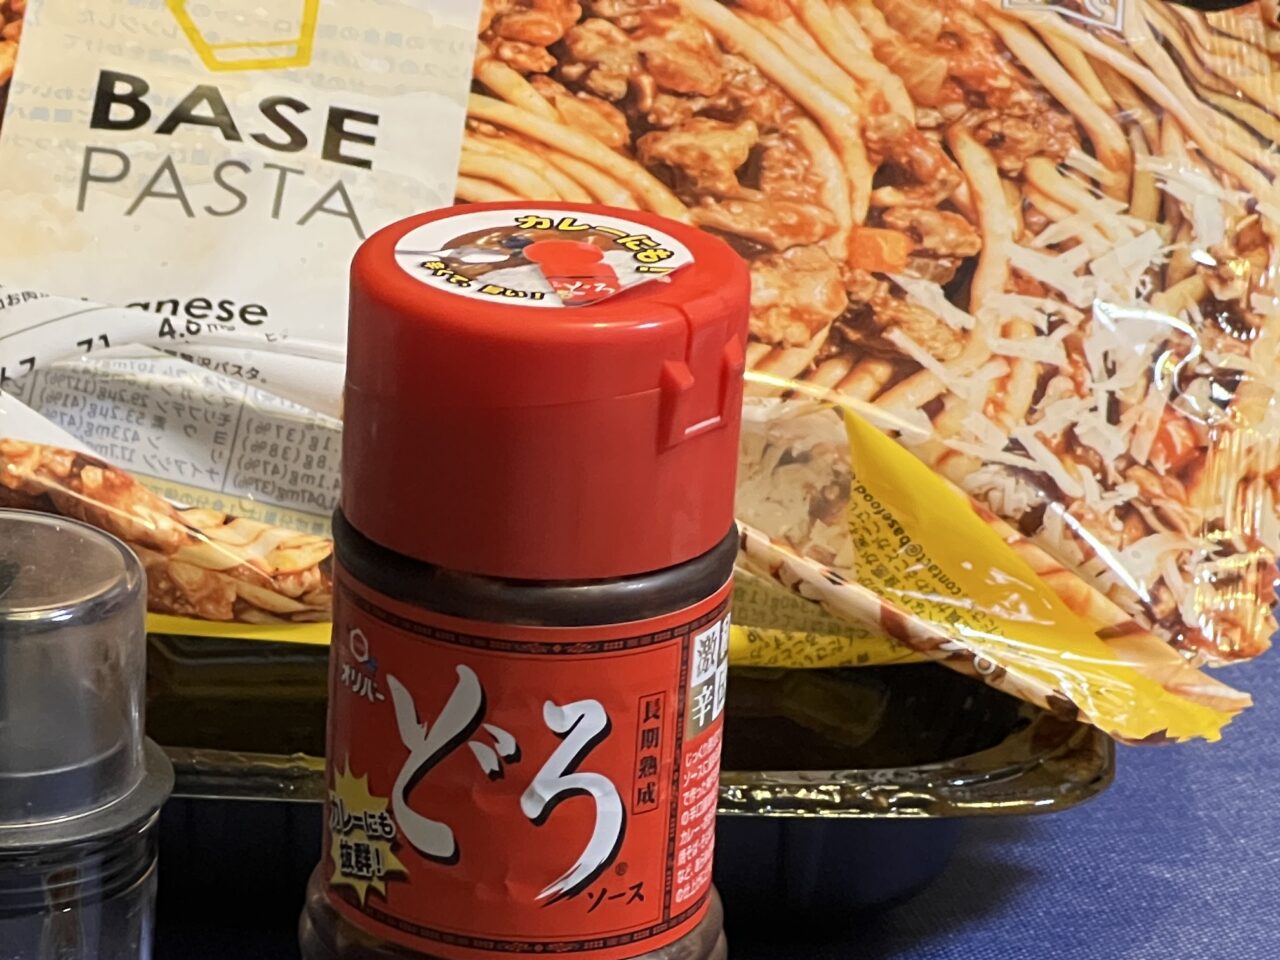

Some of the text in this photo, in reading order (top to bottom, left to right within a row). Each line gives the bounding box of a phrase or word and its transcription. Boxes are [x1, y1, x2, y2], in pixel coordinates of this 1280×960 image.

[89, 69, 380, 170] BASE
[75, 146, 367, 240] PASTA
[341, 663, 385, 702] オリバー
[386, 664, 625, 905] どろ
[637, 698, 661, 806] 長期熟成
[586, 882, 645, 913] ソース
